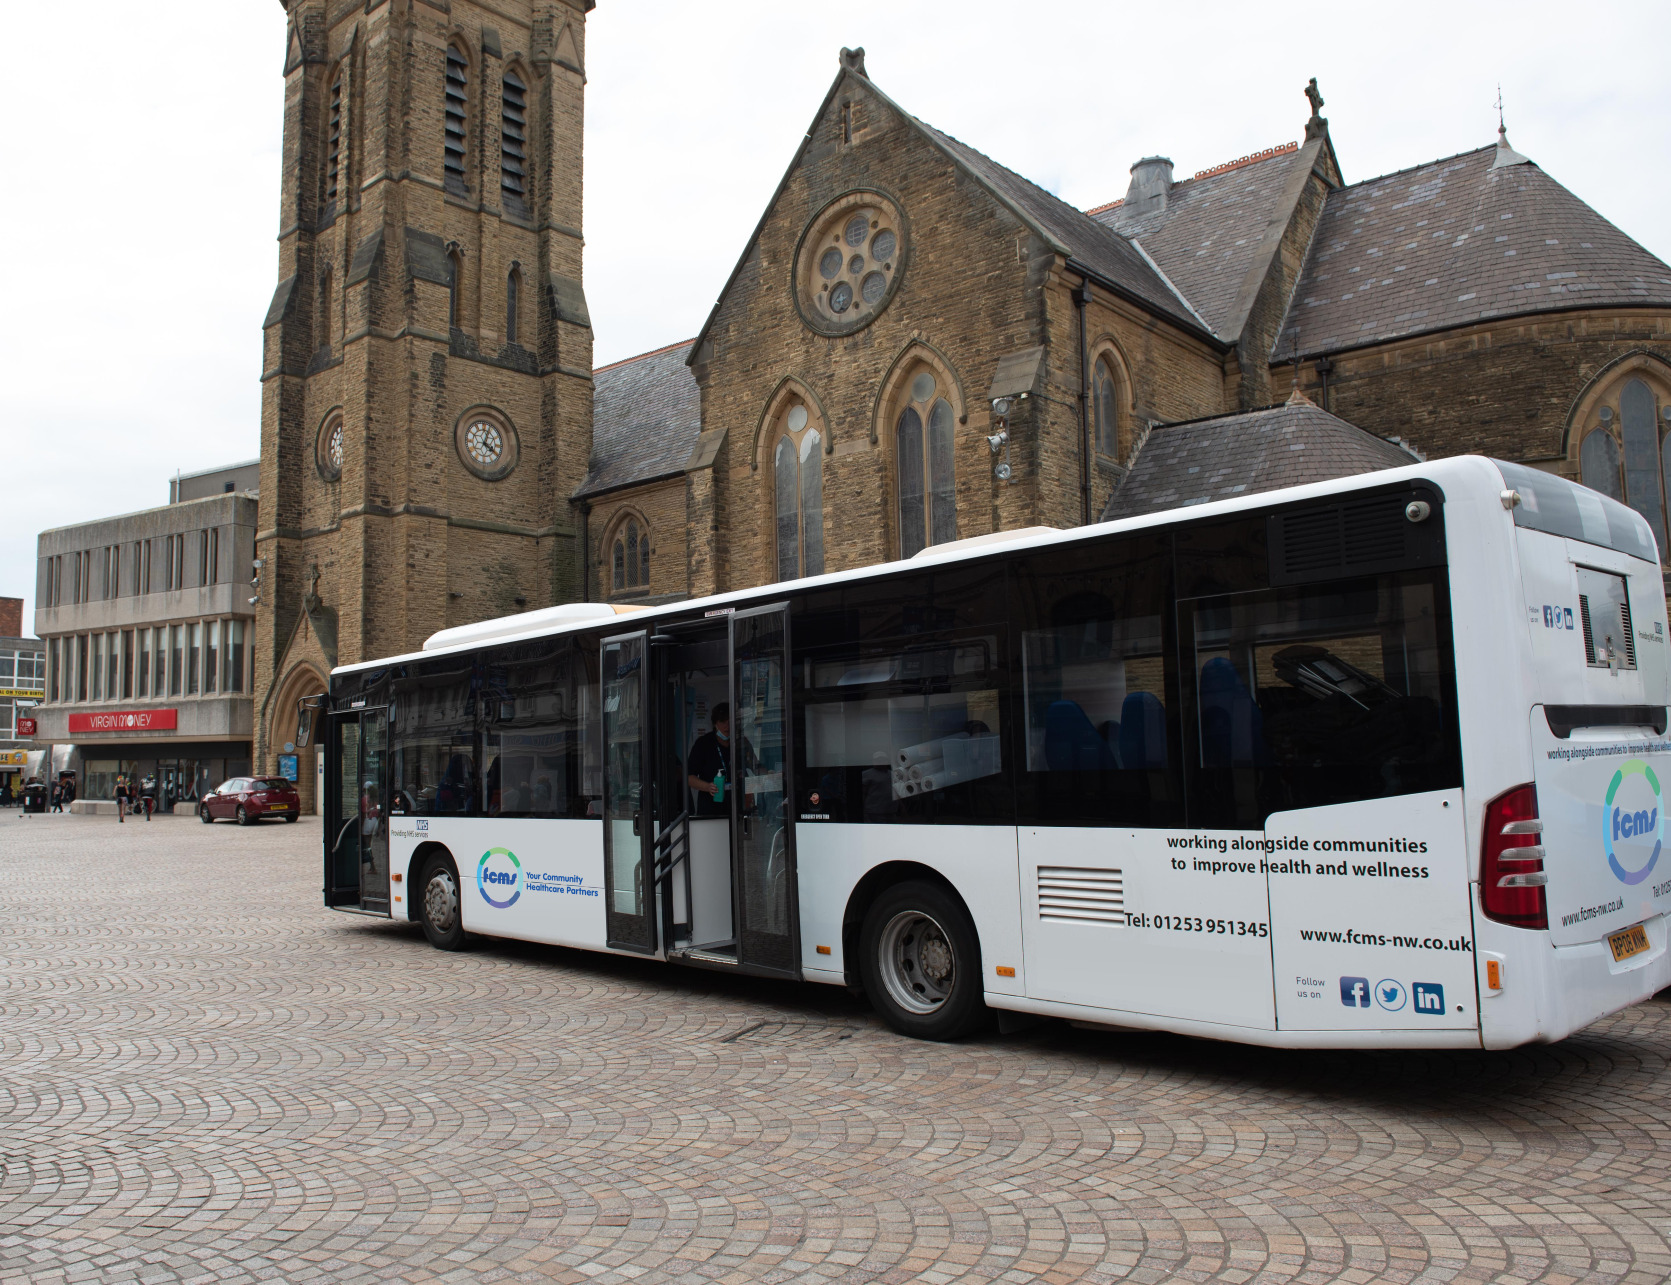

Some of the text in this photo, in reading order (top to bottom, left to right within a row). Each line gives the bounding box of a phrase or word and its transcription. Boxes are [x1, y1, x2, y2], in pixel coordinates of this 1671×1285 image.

[90, 713, 152, 728] VIRGIN MONEY
[1547, 746, 1570, 761] working
[1570, 745, 1595, 760] alongside
[1594, 744, 1622, 756] communities
[1622, 744, 1628, 755] to
[417, 820, 428, 830] NHS
[1612, 806, 1657, 841] fcms
[391, 829, 407, 838] Providing
[1167, 835, 1428, 853] working alongside communities
[483, 866, 517, 885] fcms
[1171, 857, 1429, 878] to improve health and wellness
[526, 871, 583, 885] Your Community
[526, 882, 599, 897] Healthcare Partners
[1561, 896, 1624, 927] www.fcms-nw.co.uk
[1124, 912, 1268, 938] Tel: 01253 951345
[1300, 928, 1472, 952] www.fcms-nw.co.uk
[1296, 976, 1325, 987] Follow
[1297, 990, 1321, 999] us on
